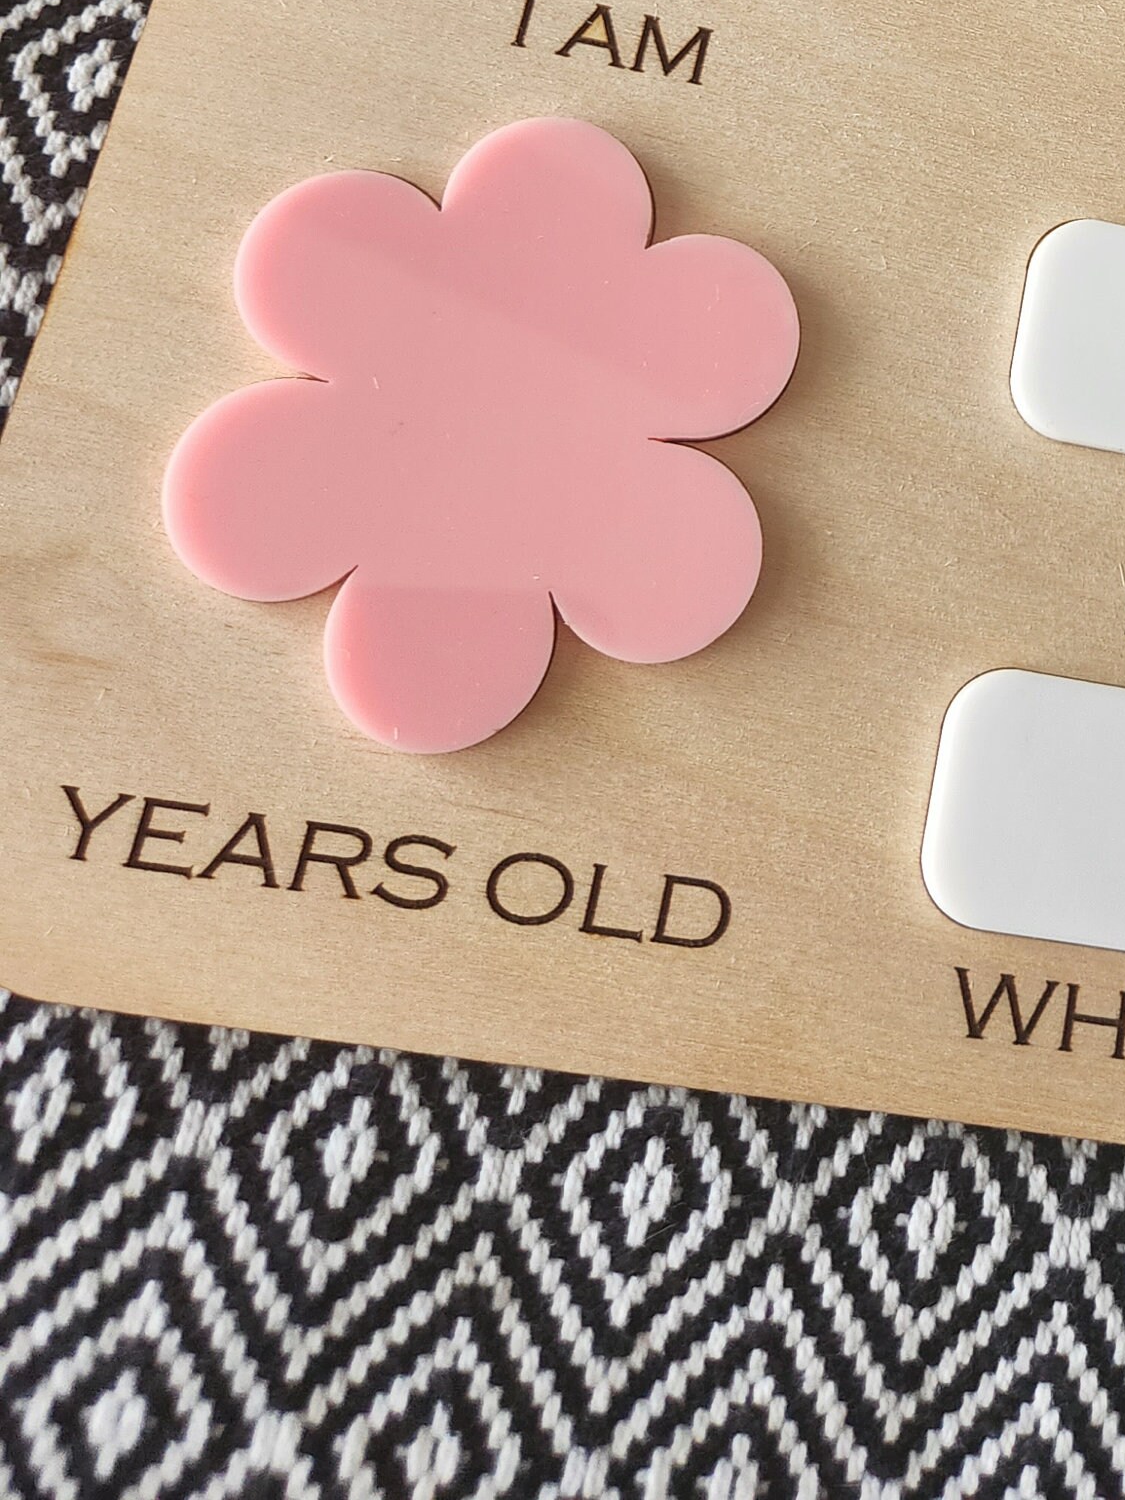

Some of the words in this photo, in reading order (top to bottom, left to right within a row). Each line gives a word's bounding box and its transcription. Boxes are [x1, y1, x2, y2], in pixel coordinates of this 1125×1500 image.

[555, 3, 714, 85] AM
[61, 785, 457, 910] YEARS
[485, 853, 733, 949] OLD
